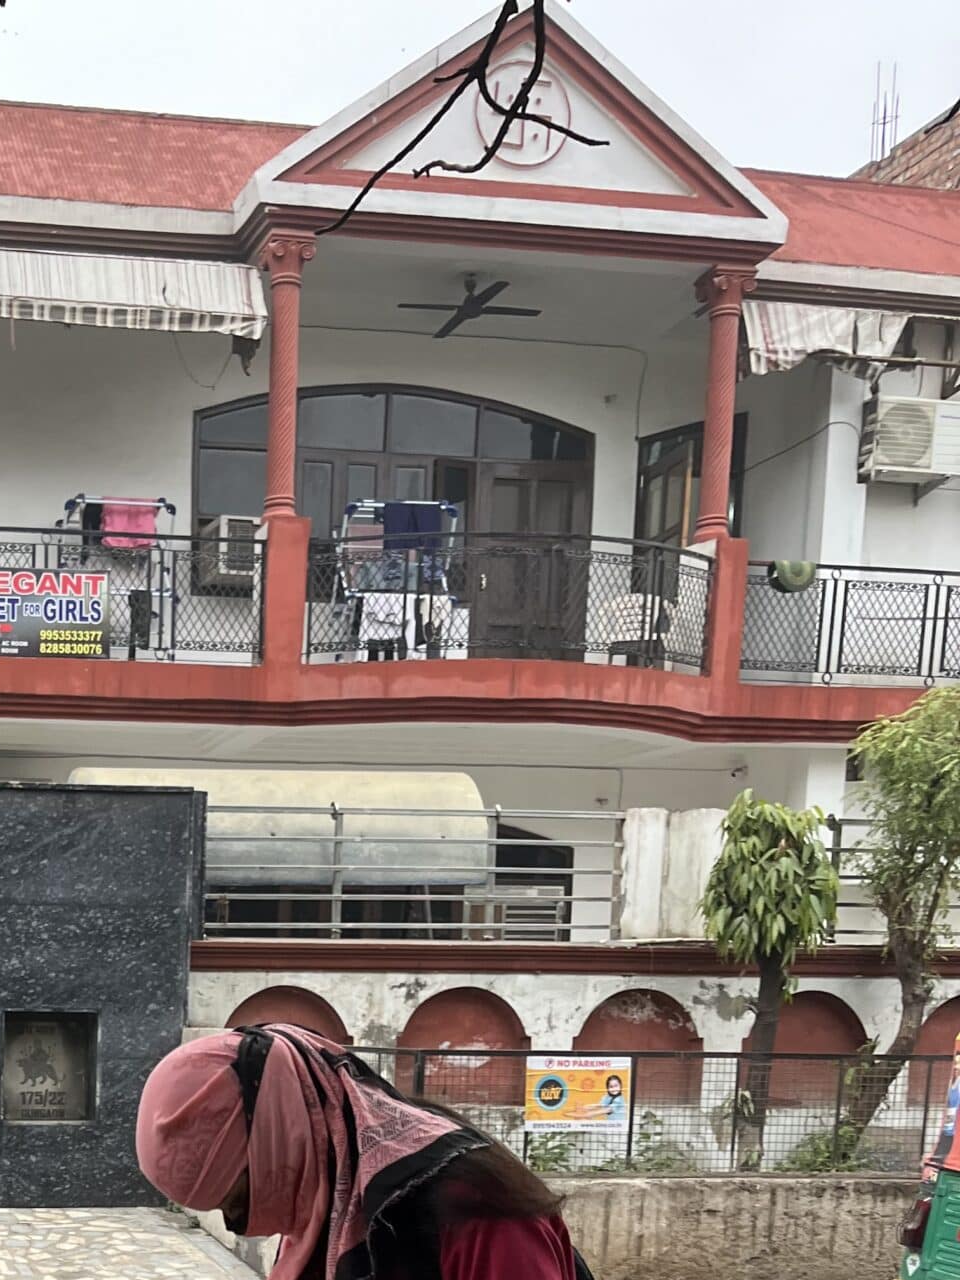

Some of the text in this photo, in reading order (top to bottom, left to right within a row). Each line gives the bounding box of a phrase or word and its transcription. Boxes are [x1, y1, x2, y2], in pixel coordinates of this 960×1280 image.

[23, 603, 41, 617] FOR
[42, 598, 102, 624] GIRLS
[40, 630, 102, 641] 9953533377
[40, 642, 102, 654] 8285830076
